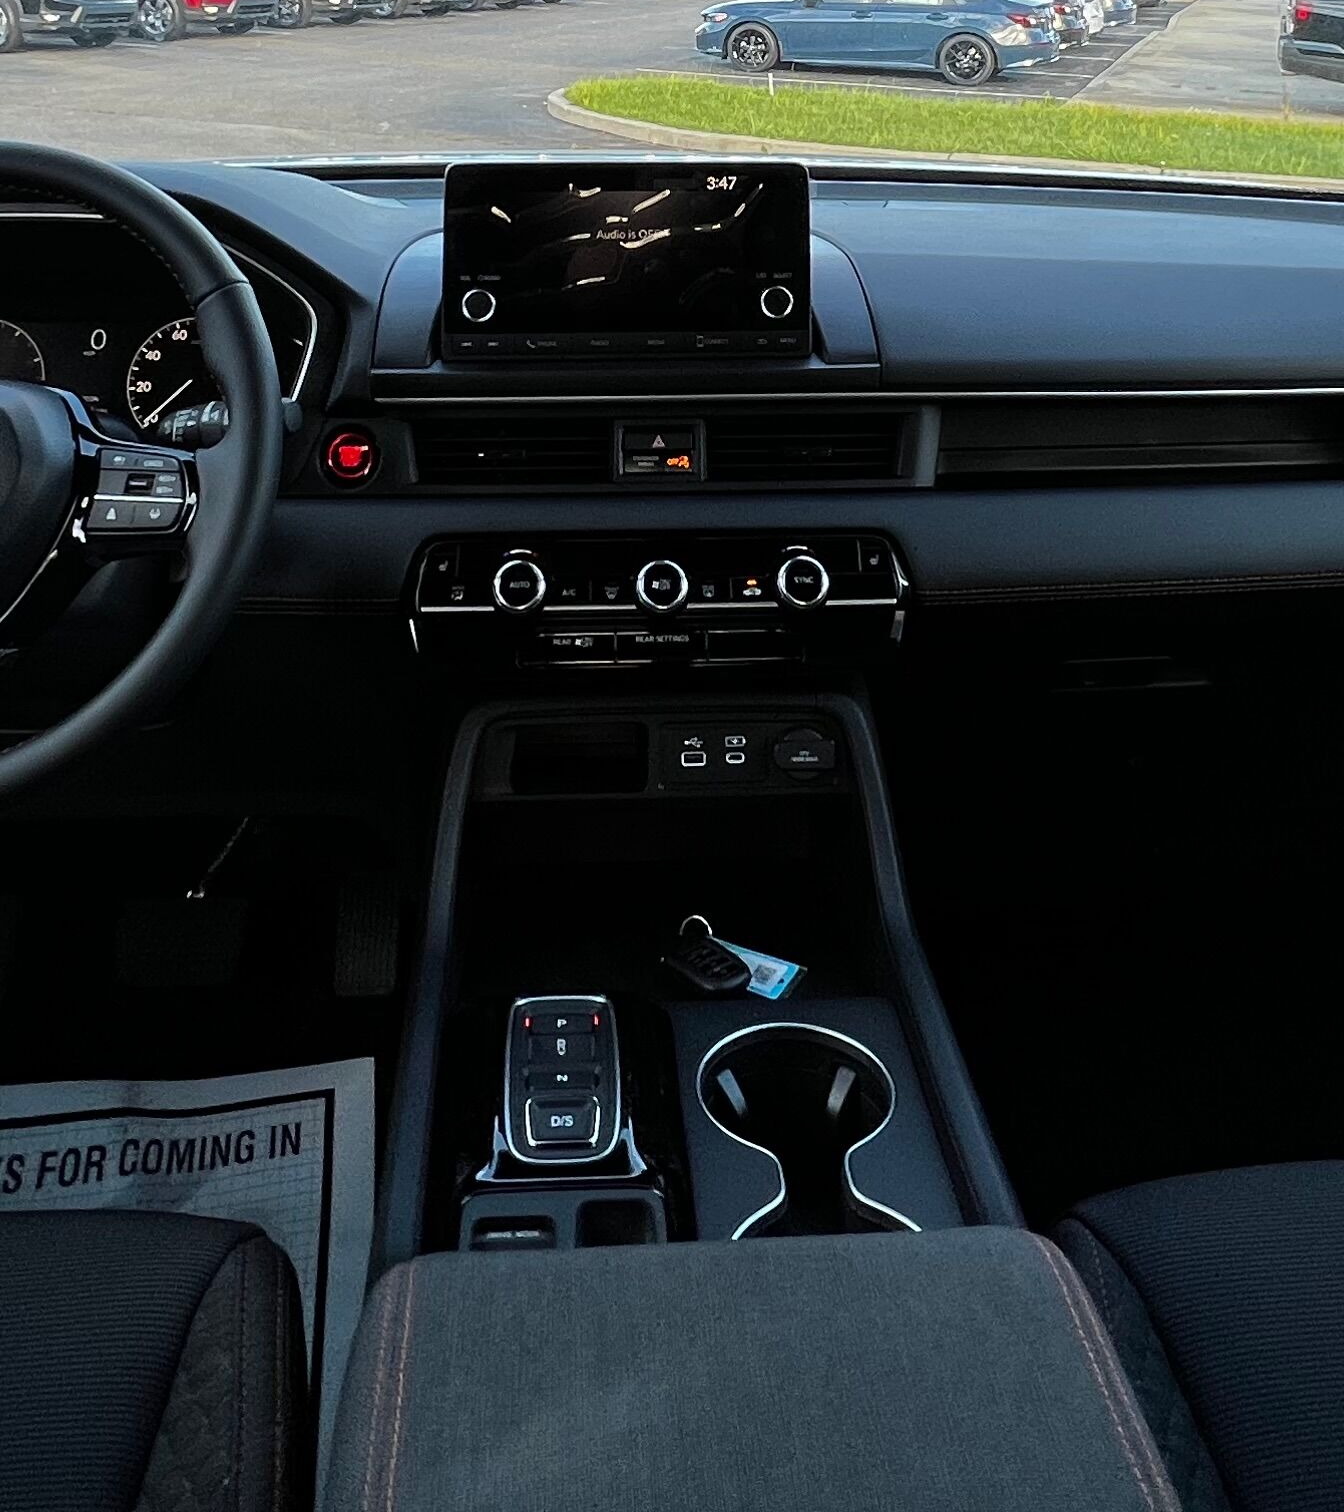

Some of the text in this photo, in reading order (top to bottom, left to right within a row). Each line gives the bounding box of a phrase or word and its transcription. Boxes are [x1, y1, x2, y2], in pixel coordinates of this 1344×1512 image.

[705, 176, 737, 192] 3:47
[596, 229, 625, 240] Audio
[627, 229, 636, 239] is
[90, 328, 107, 350] 0
[171, 330, 188, 341] 60
[144, 350, 162, 361] 40
[135, 381, 152, 393] 20
[509, 580, 530, 589] AUTO
[561, 588, 577, 597] A/C
[550, 1115, 574, 1128] D/S
[35, 1144, 107, 1191] FOR
[118, 1129, 256, 1177] COMING
[267, 1121, 303, 1160] IN
